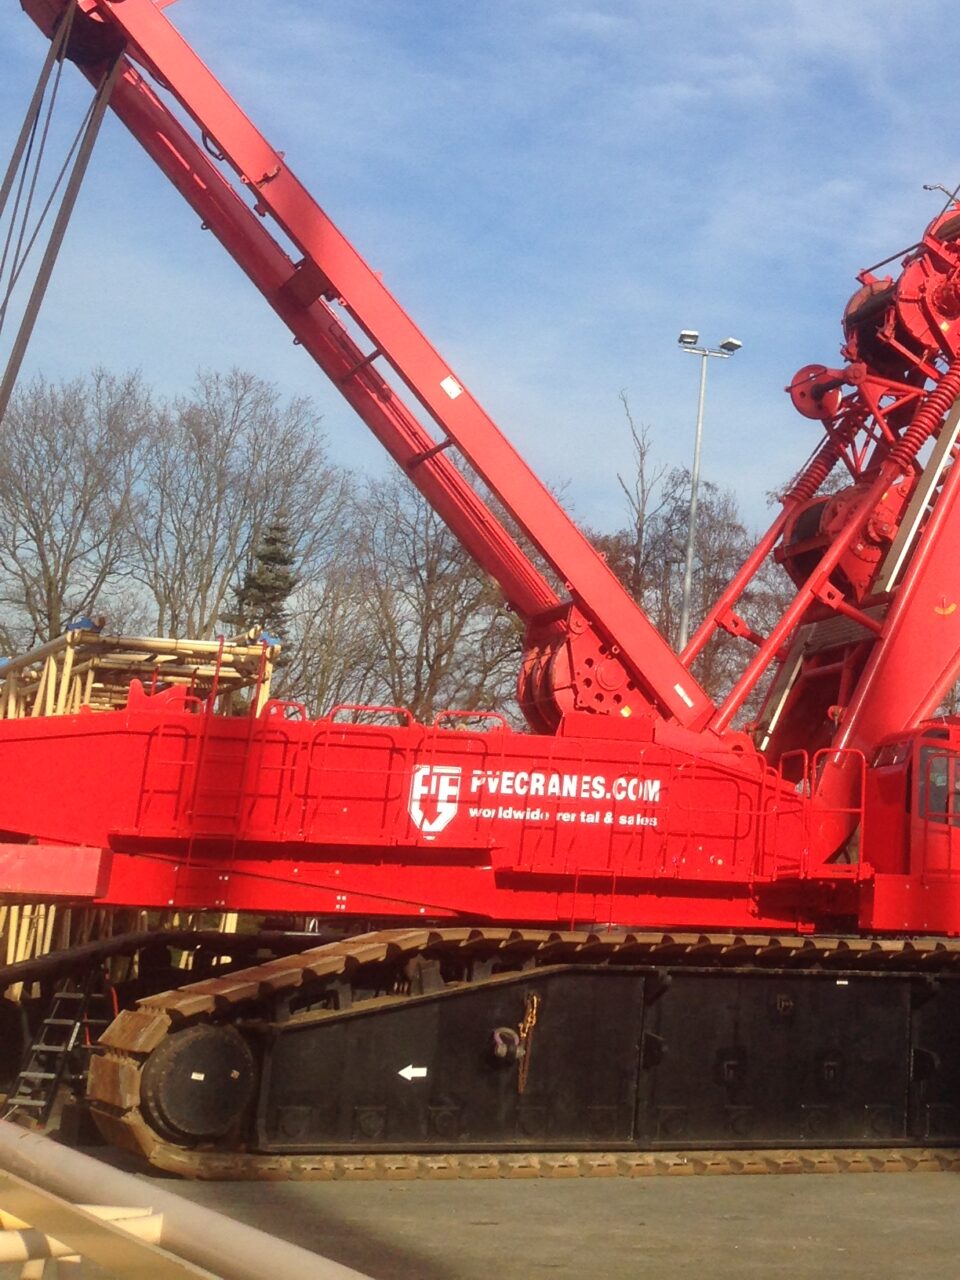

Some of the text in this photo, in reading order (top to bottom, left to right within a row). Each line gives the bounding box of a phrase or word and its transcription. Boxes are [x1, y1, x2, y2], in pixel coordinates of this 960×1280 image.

[470, 769, 661, 802] PVECRANES.COM
[469, 806, 550, 821] worldwide
[603, 811, 613, 824] &
[618, 813, 658, 827] sales
